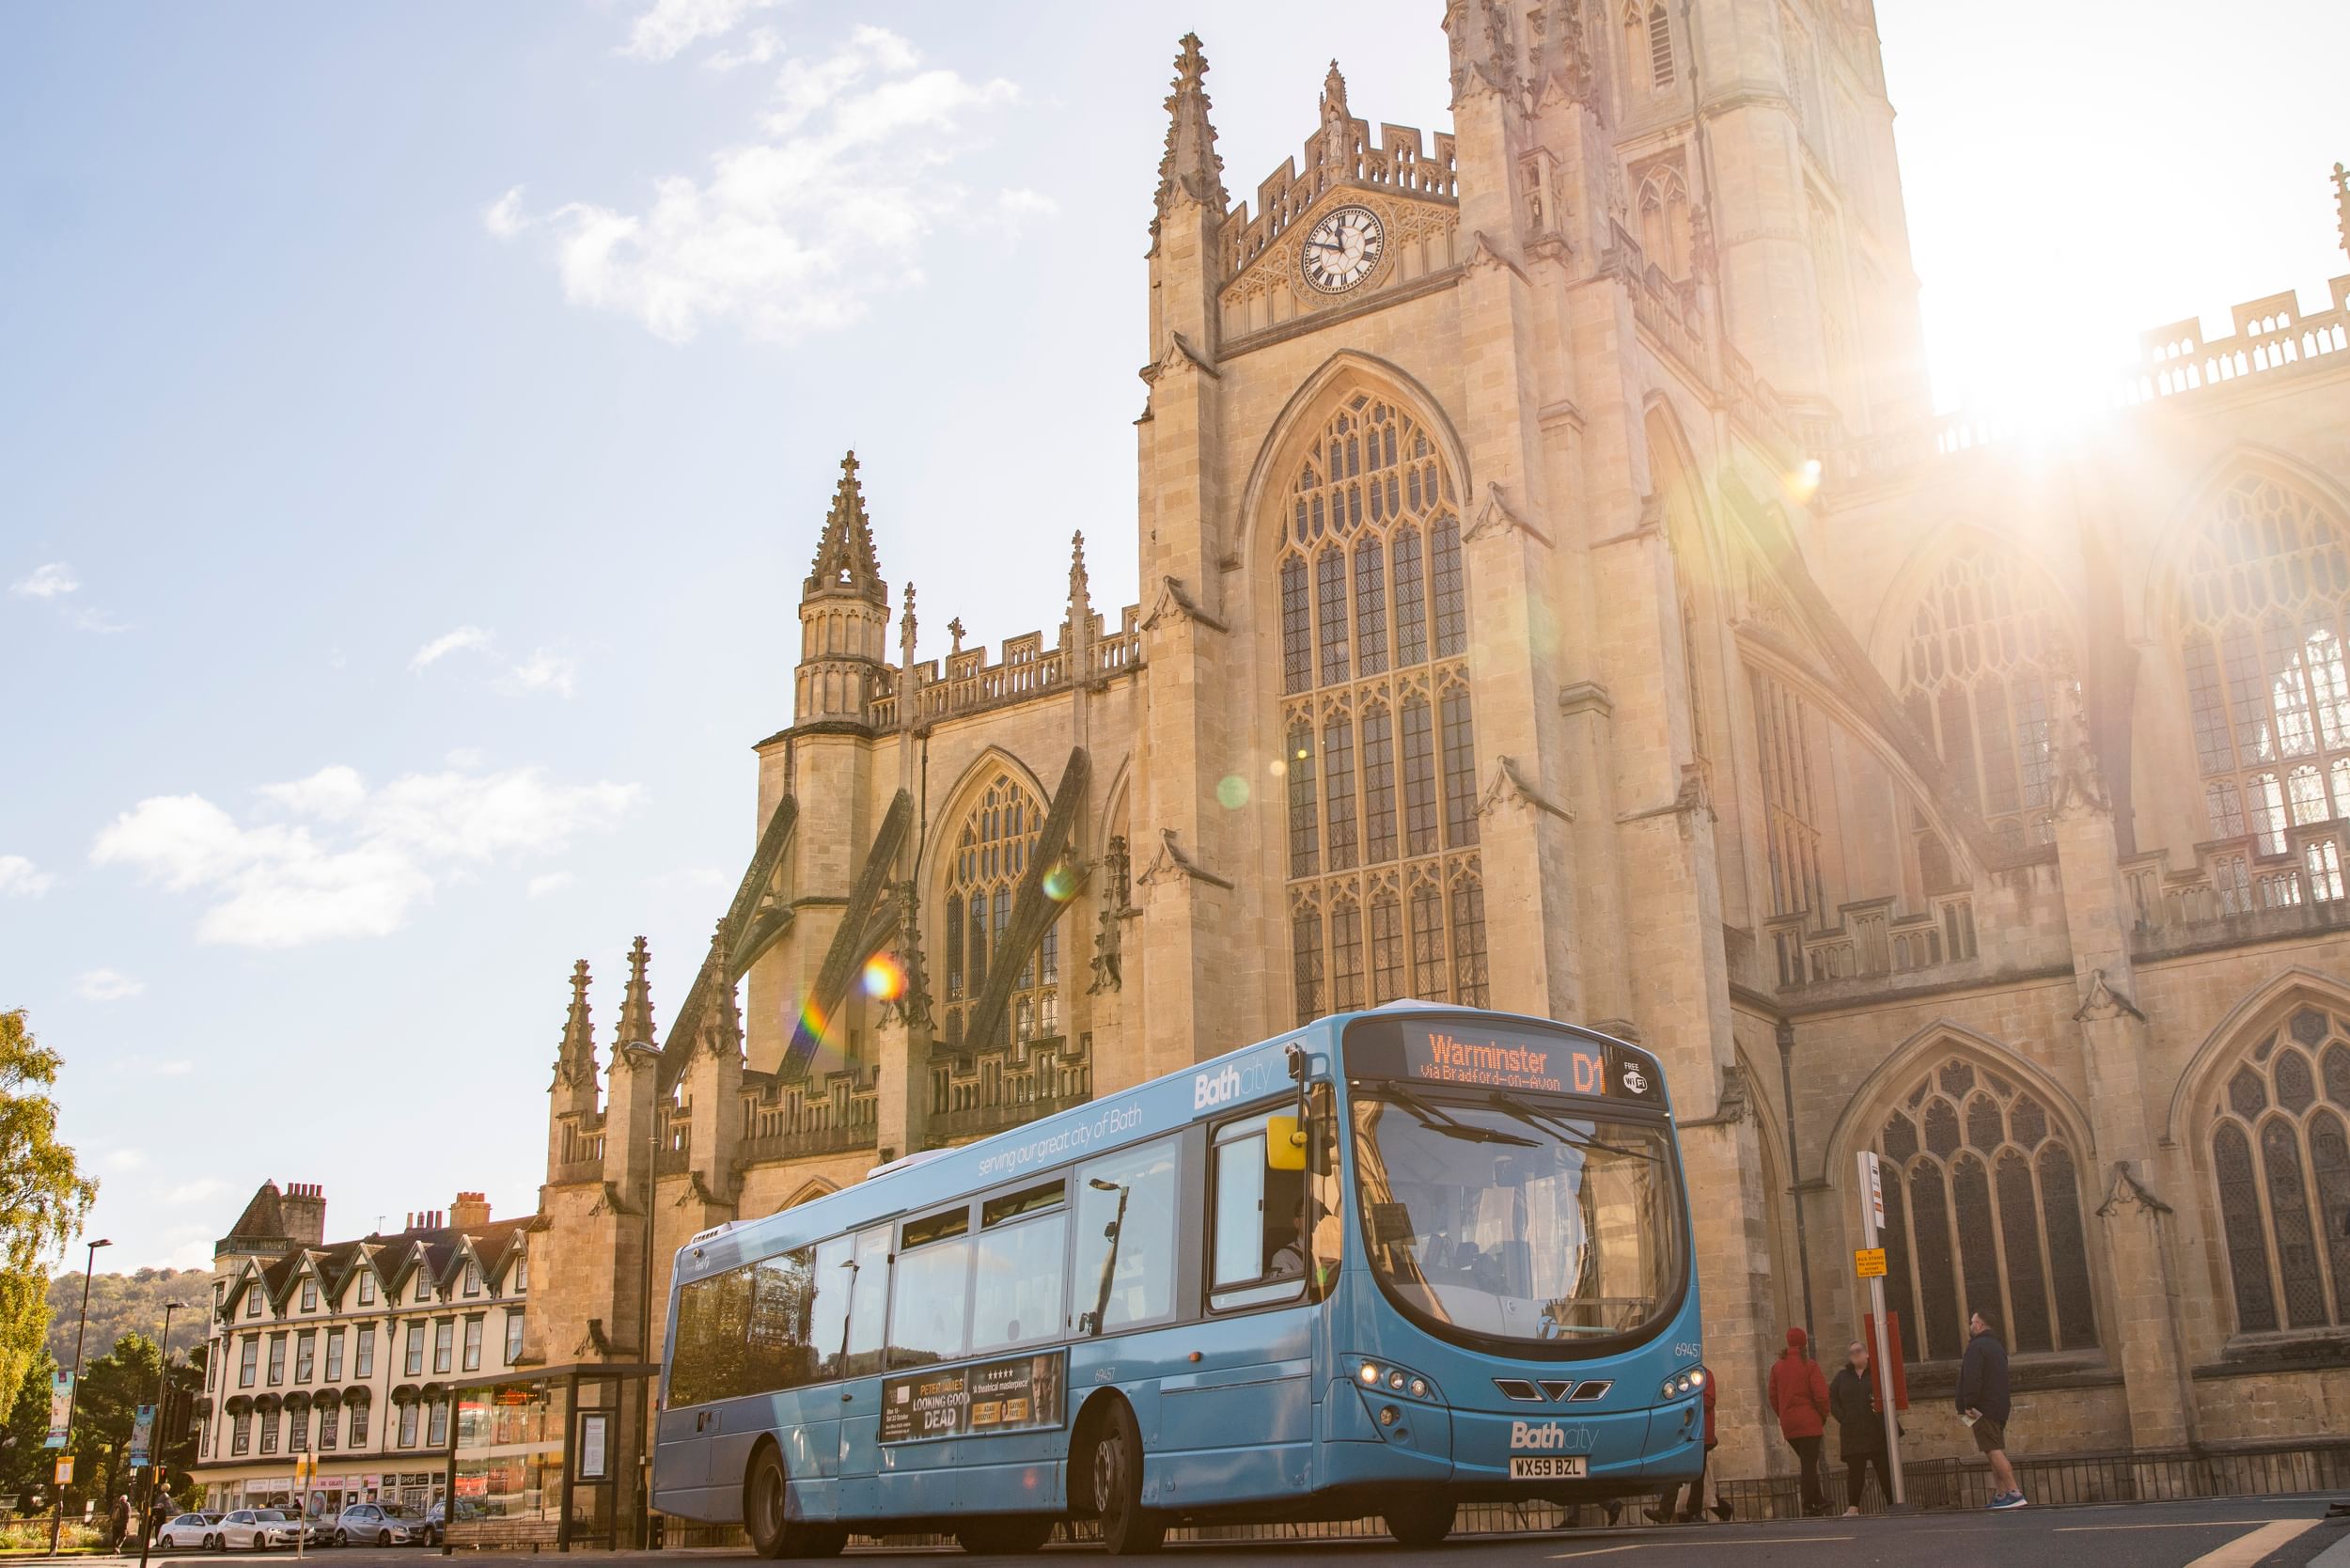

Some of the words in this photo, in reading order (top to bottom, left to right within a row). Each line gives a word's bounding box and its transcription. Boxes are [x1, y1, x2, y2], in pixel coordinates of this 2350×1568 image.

[1429, 1033, 1548, 1074] Warminster
[1573, 1053, 1606, 1094] D1
[1624, 1062, 1639, 1071] FREE
[1420, 1063, 1440, 1078] via
[1443, 1065, 1560, 1091] Bradford-on-Avon
[979, 1149, 1016, 1176] serving
[1017, 1142, 1038, 1164] our
[1037, 1130, 1070, 1163] great
[1071, 1121, 1094, 1148] city
[1093, 1111, 1109, 1138] of
[1110, 1102, 1142, 1134] Bath
[1675, 1342, 1701, 1358] 69457
[1094, 1367, 1116, 1383] 69457
[920, 1382, 940, 1396] PETER
[941, 1378, 964, 1391] JAMES
[978, 1381, 998, 1393] theatrical
[913, 1395, 947, 1412] LOOKING
[947, 1391, 970, 1406] GOOD
[924, 1407, 956, 1430] DEAD
[1515, 1459, 1552, 1477] WX59
[1555, 1459, 1581, 1477] BZL
[401, 1475, 415, 1483] SHOP
